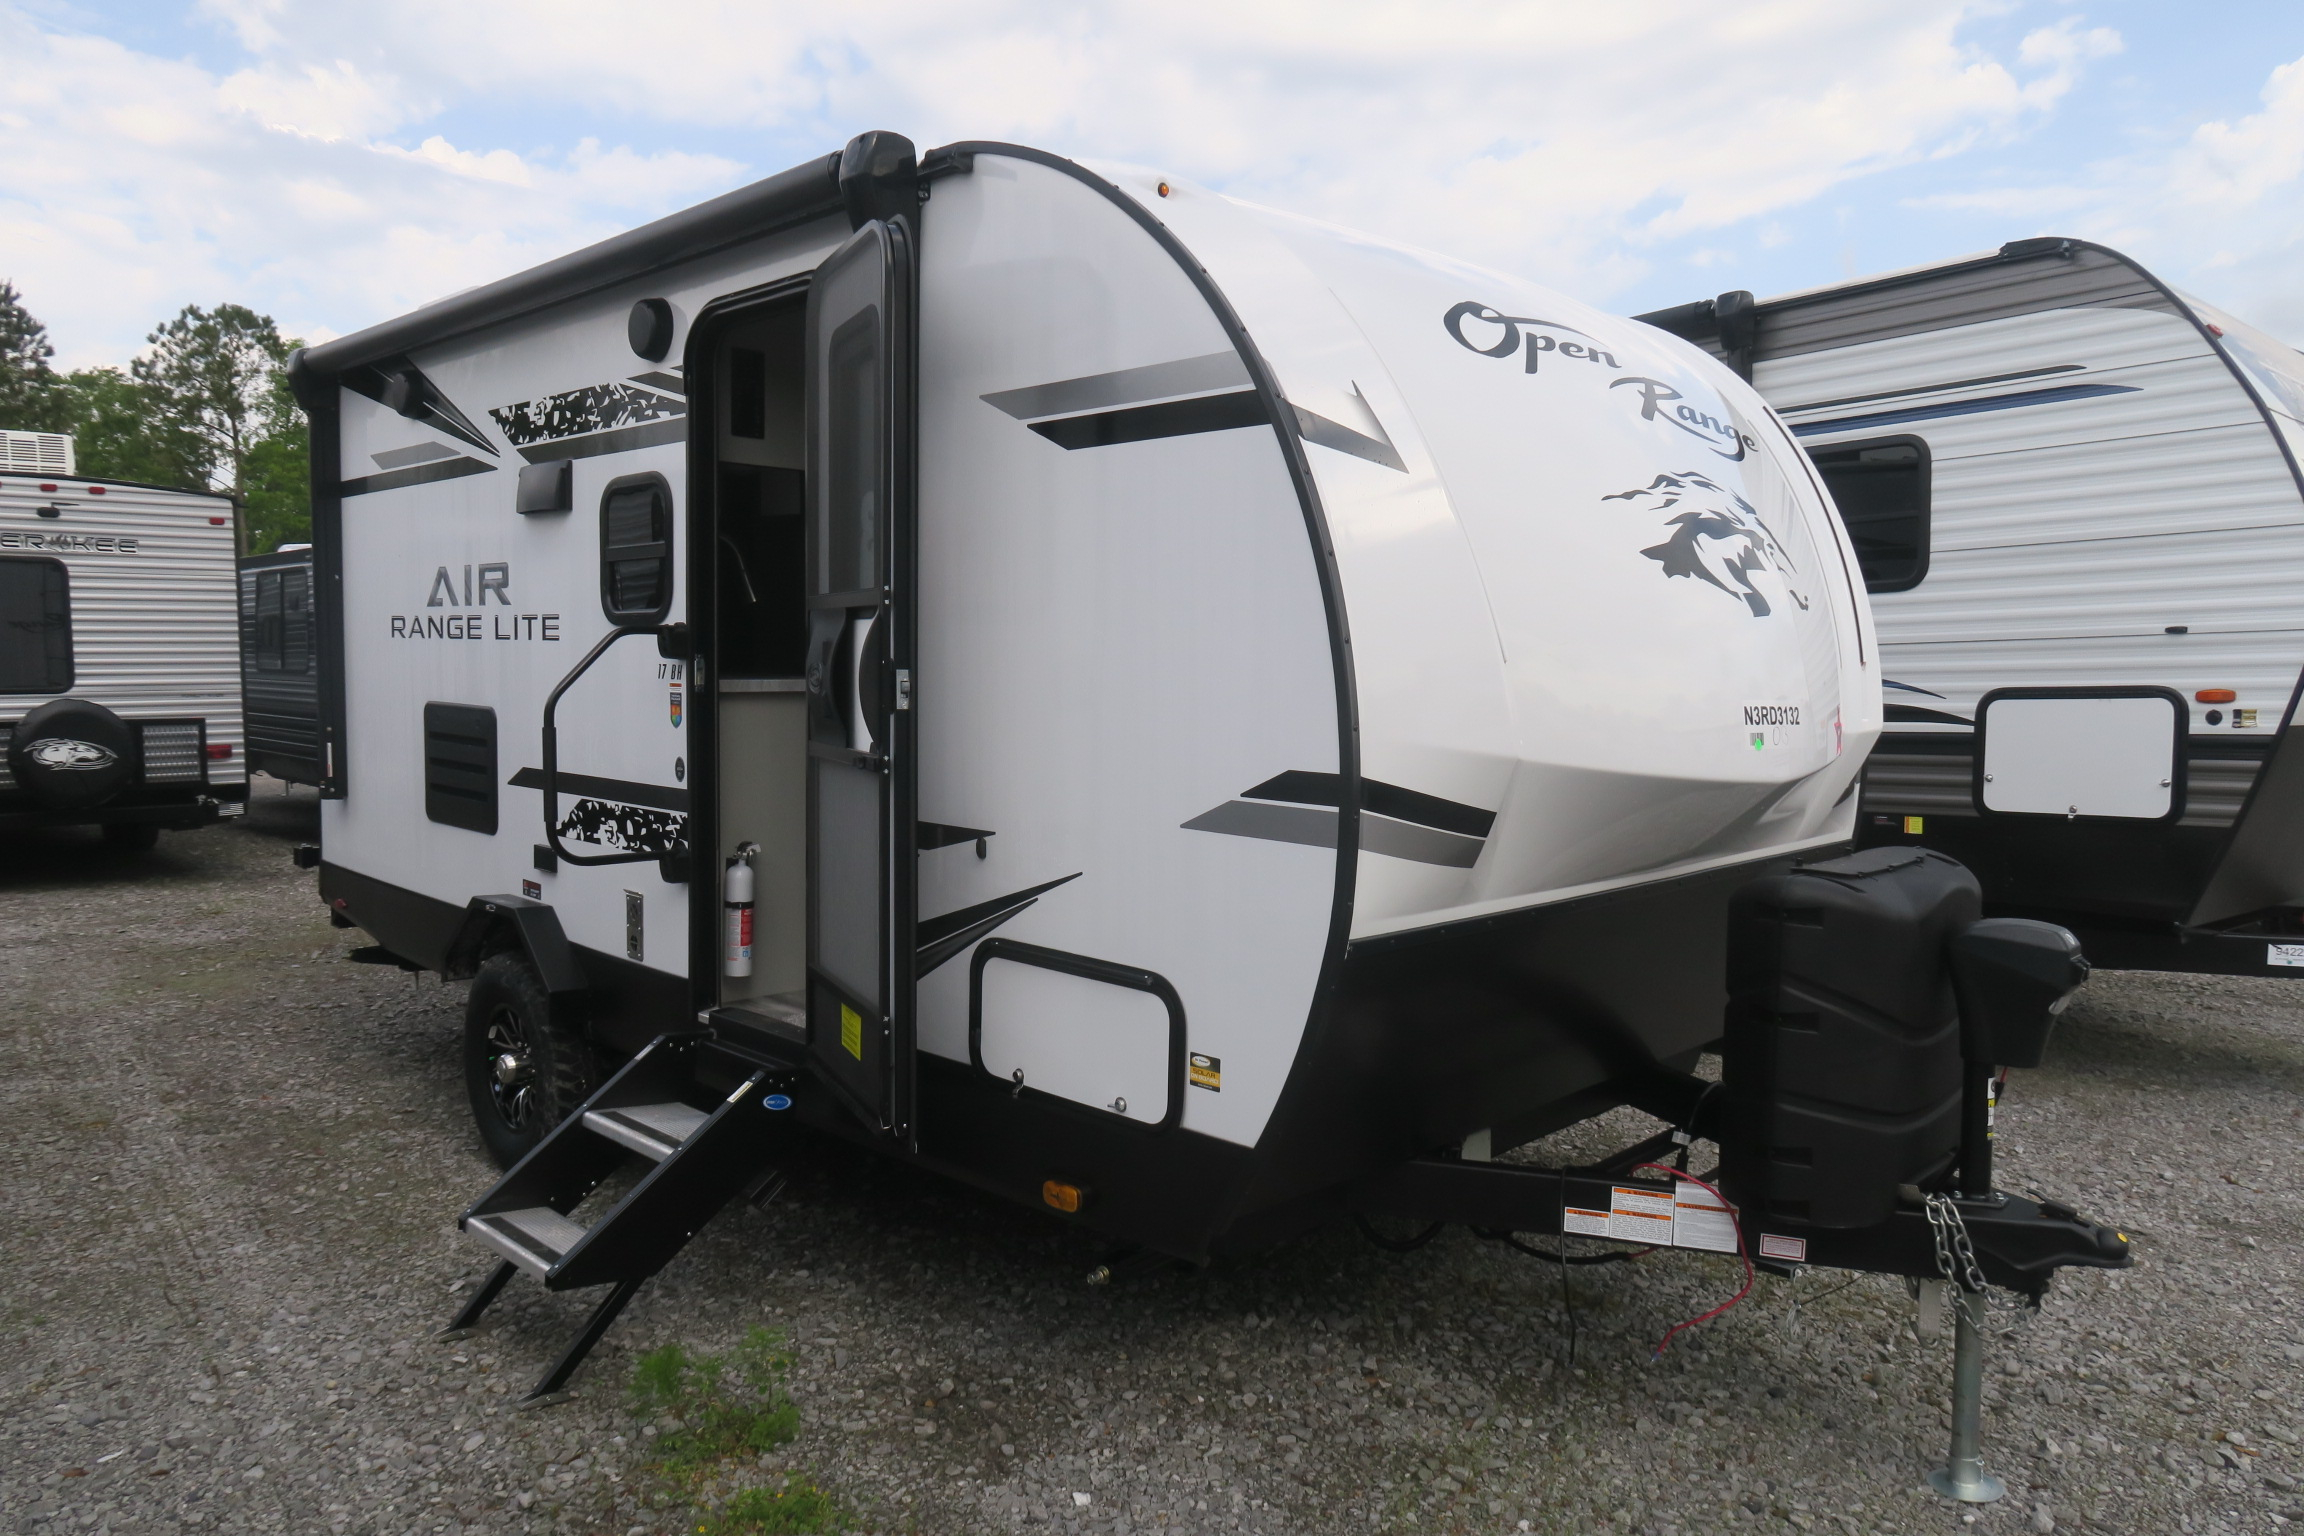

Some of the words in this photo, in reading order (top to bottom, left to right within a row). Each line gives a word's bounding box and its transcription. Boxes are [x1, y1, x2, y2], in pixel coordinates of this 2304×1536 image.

[1444, 301, 1622, 374] Open
[1609, 377, 1760, 462] Range
[427, 562, 511, 607] AIR
[391, 615, 482, 640] RANGE
[495, 613, 560, 641] LITE
[658, 664, 667, 679] 17
[670, 664, 683, 680] BH
[1744, 706, 1800, 725] N3RD3132
[1192, 1068, 1216, 1079] SOLAR
